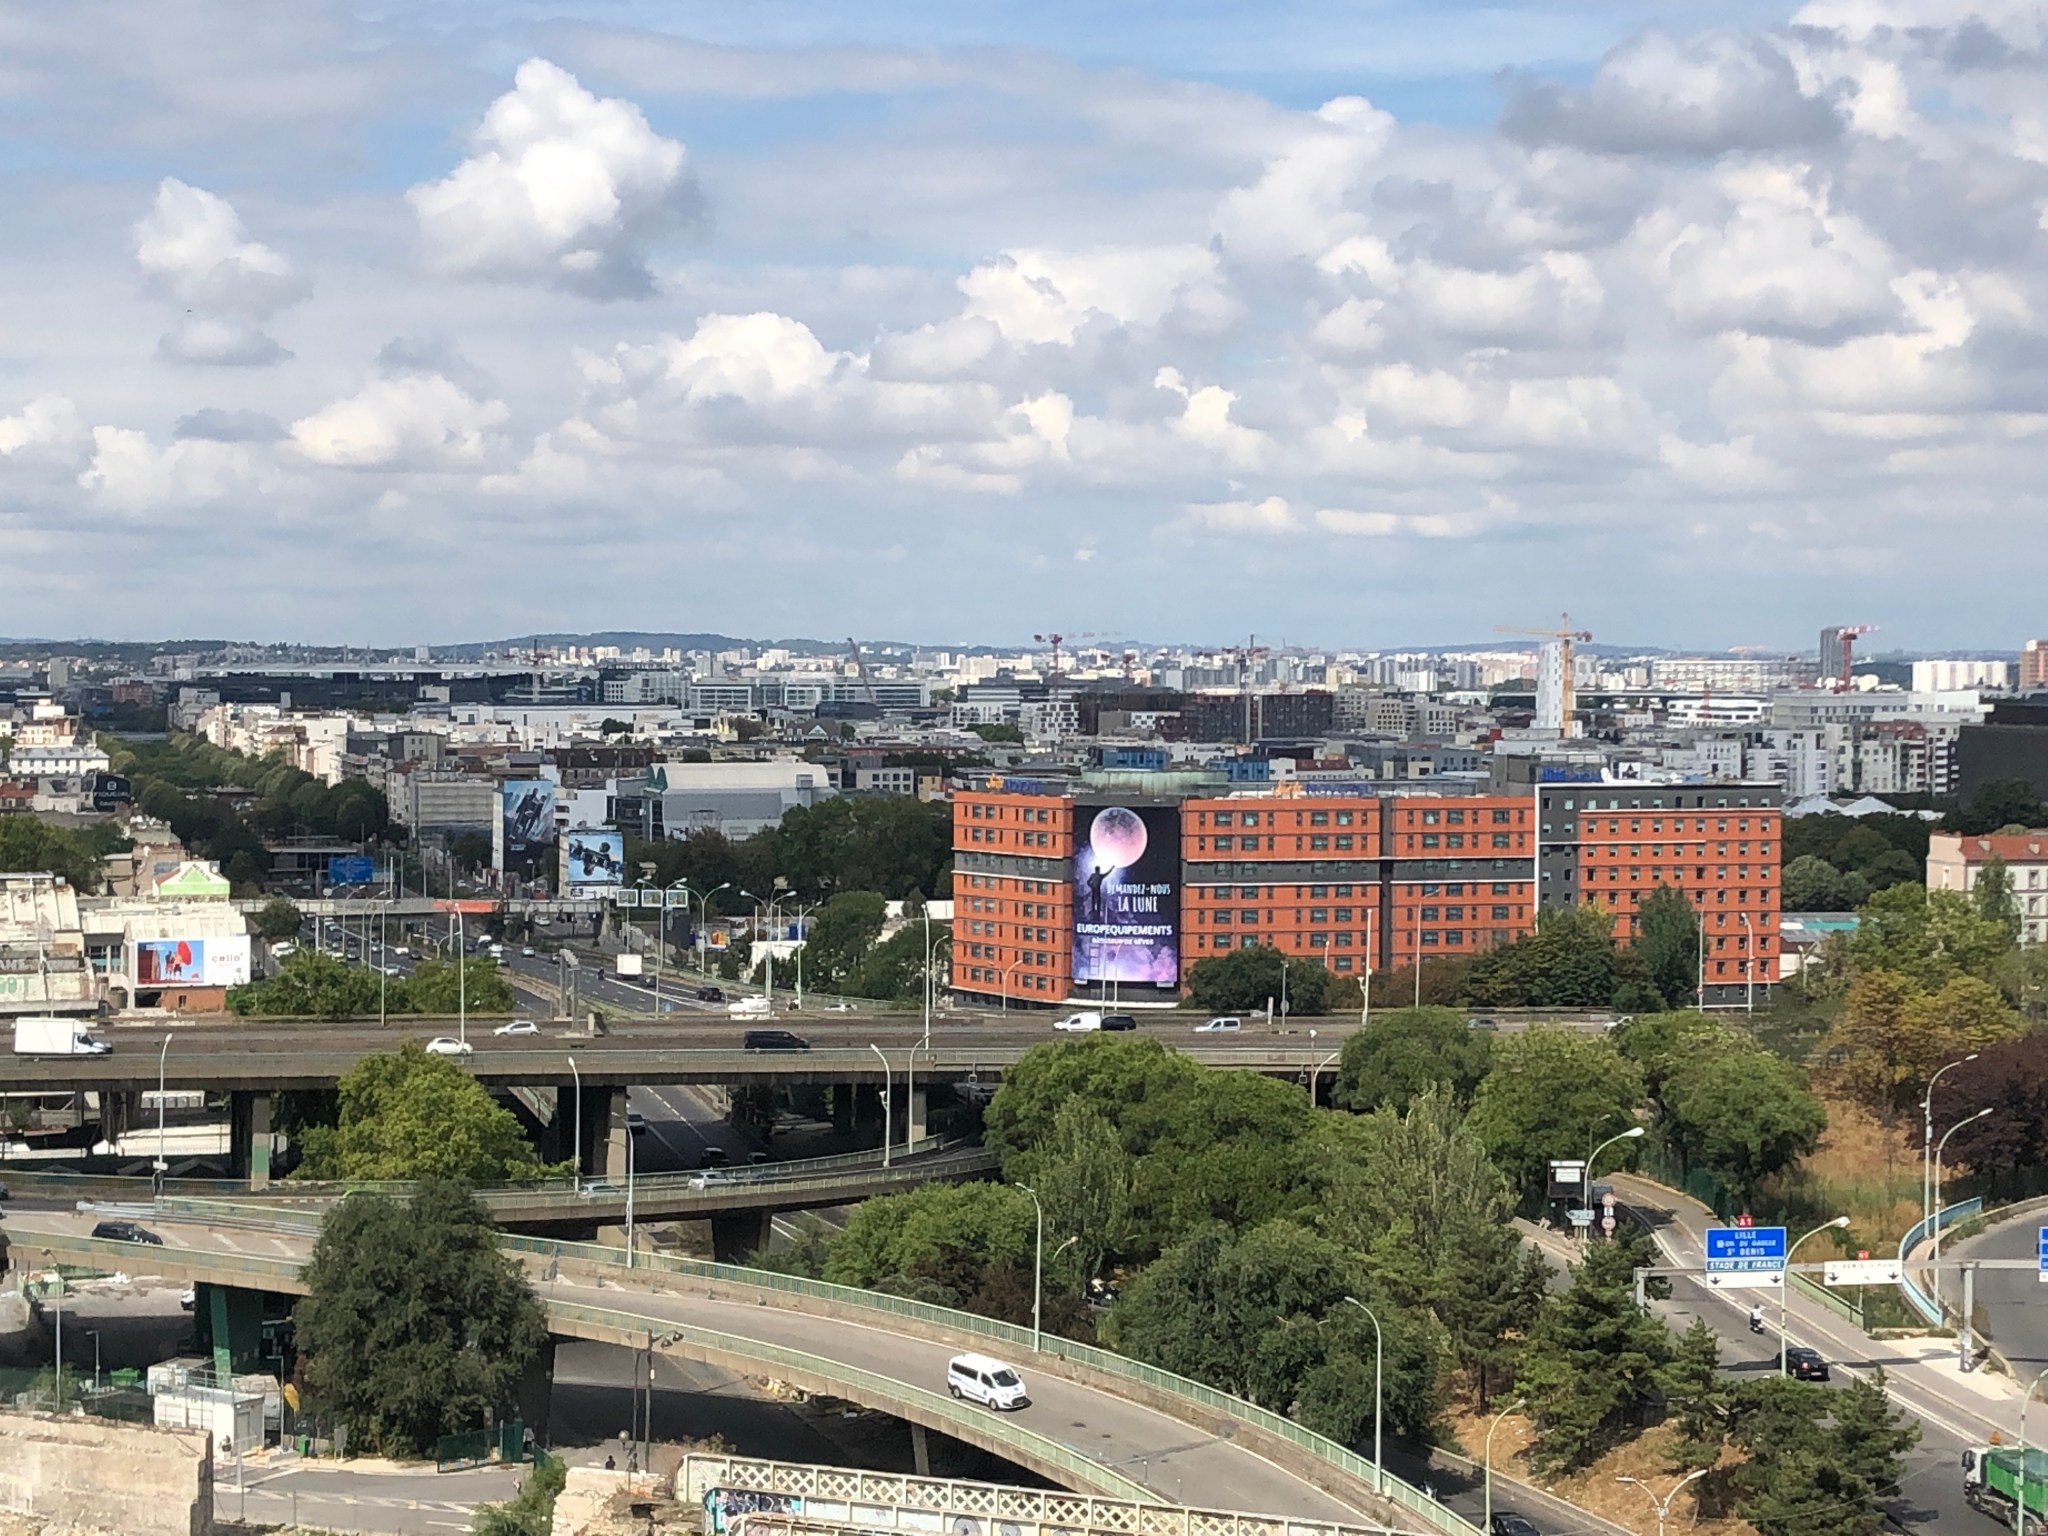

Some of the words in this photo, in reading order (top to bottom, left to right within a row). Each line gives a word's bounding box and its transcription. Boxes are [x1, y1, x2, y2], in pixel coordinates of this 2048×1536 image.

[1118, 896, 1129, 912] LA
[1132, 896, 1158, 912] LUNE
[1076, 923, 1173, 936] EUROPEQUIPEMENTS
[1740, 1217, 1752, 1226] A1
[1734, 1231, 1757, 1240] LILLE
[1739, 1247, 1765, 1256] DENIS
[1709, 1260, 1735, 1269] STADE
[1751, 1260, 1781, 1269] FRANCE
